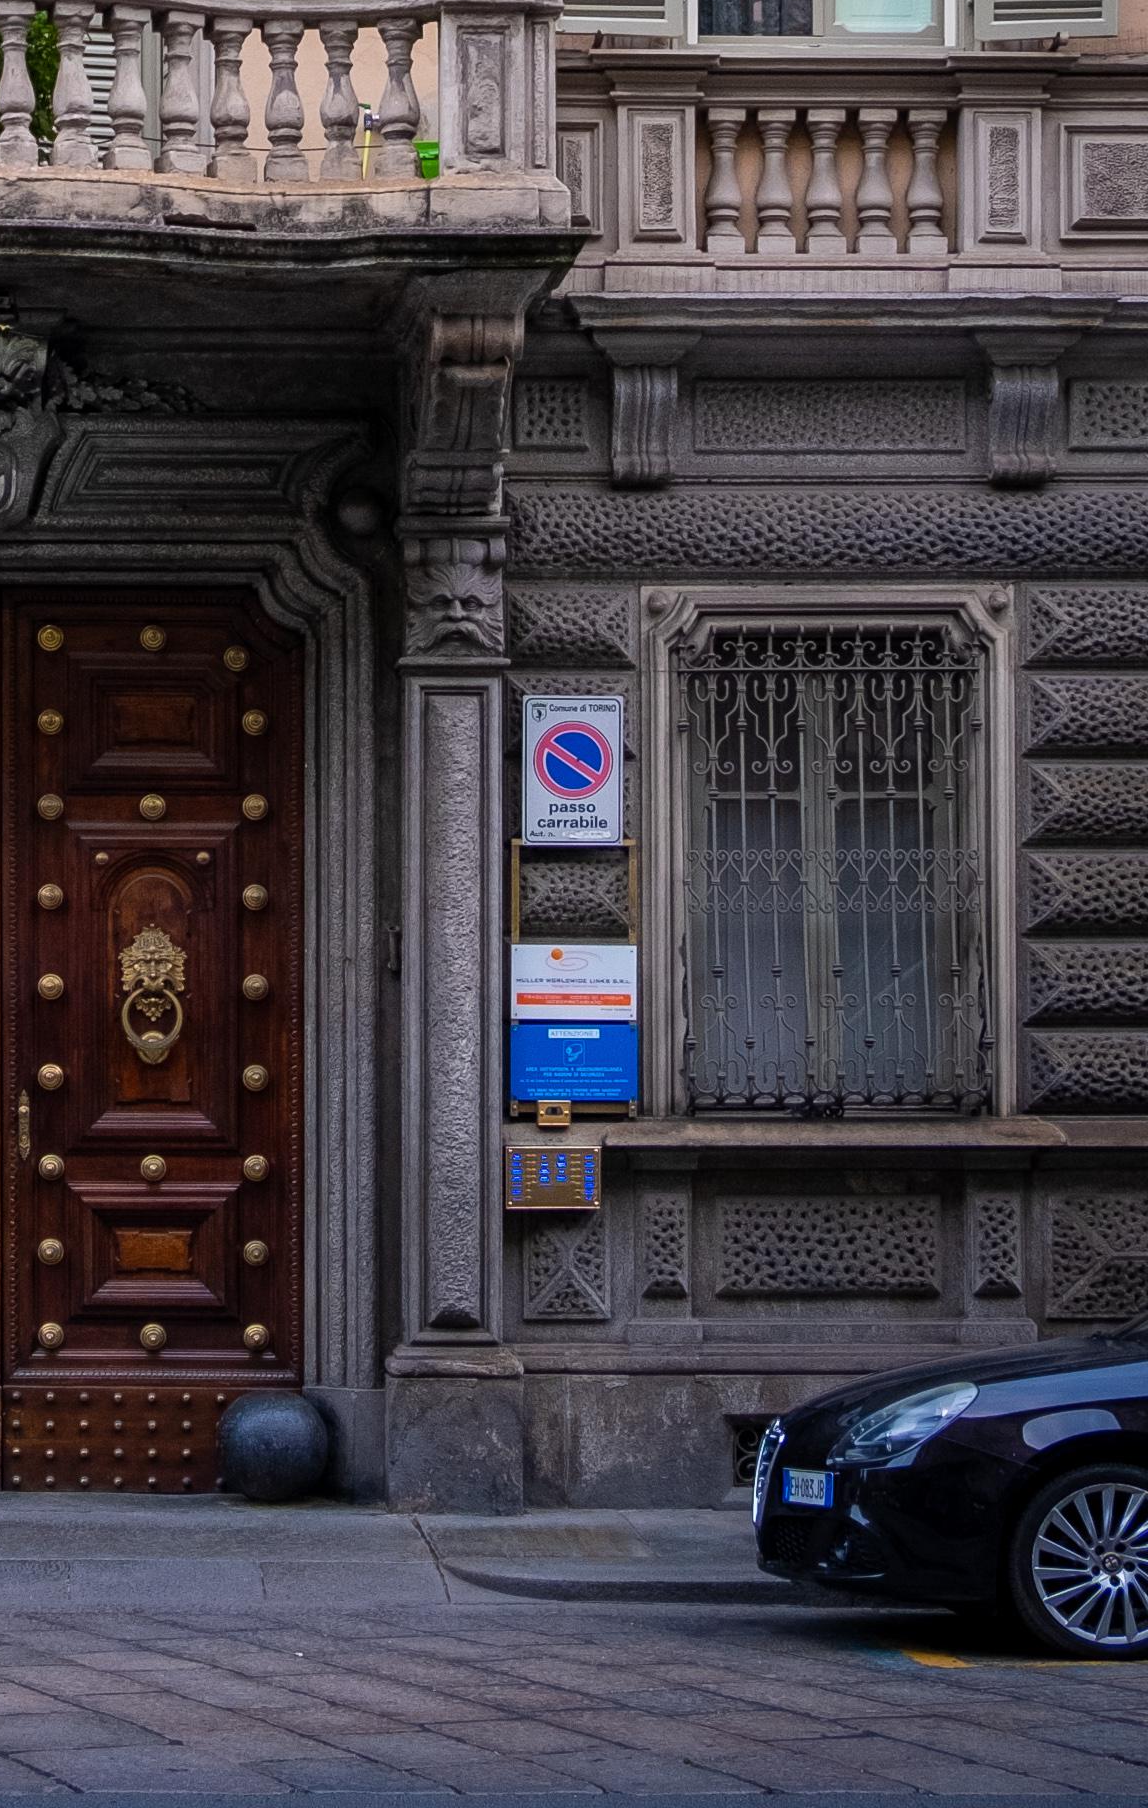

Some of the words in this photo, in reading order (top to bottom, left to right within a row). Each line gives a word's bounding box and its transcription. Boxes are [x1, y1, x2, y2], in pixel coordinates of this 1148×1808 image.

[549, 703, 578, 712] Comune
[580, 703, 587, 712] di
[589, 703, 617, 712] TORINO
[549, 803, 596, 815] passo
[537, 816, 608, 828] carrabile
